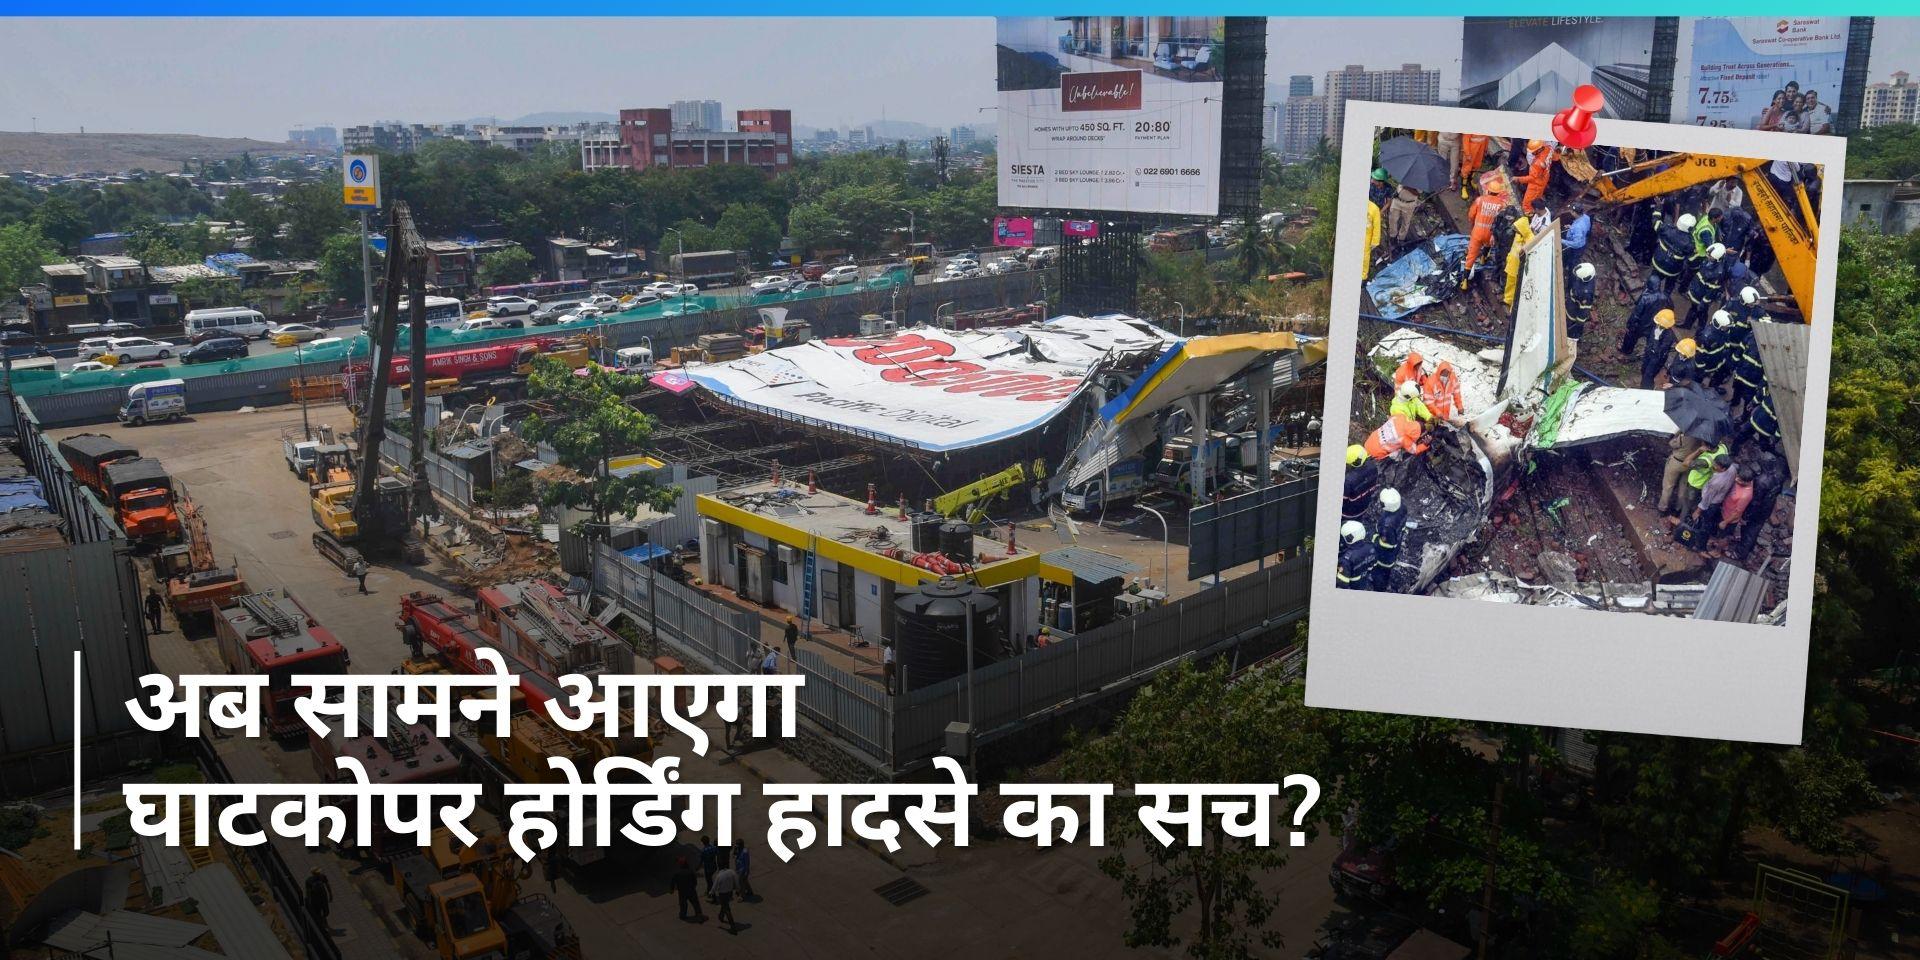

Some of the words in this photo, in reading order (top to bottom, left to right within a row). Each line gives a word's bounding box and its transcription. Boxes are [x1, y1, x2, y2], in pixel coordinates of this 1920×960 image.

[1793, 18, 1820, 26] Saraswat
[1778, 36, 1814, 44] Co-operative
[1700, 64, 1721, 72] Building
[1723, 63, 1736, 71] Trust
[1069, 83, 1135, 103] Unbelievable!
[1698, 87, 1730, 105] 7.75
[1113, 122, 1125, 131] FT.
[1696, 116, 1728, 128] 725
[1695, 157, 1717, 168] JCB
[1011, 164, 1045, 175] SIESTA
[1143, 167, 1158, 175] 022
[1180, 168, 1201, 176] 6666
[1482, 201, 1502, 211] NDRF
[432, 354, 452, 367] AMRIK
[453, 353, 471, 364] SINGH
[471, 353, 479, 363] &
[479, 351, 497, 363] SONS
[793, 391, 887, 414] Pacific
[880, 408, 979, 429] Digital
